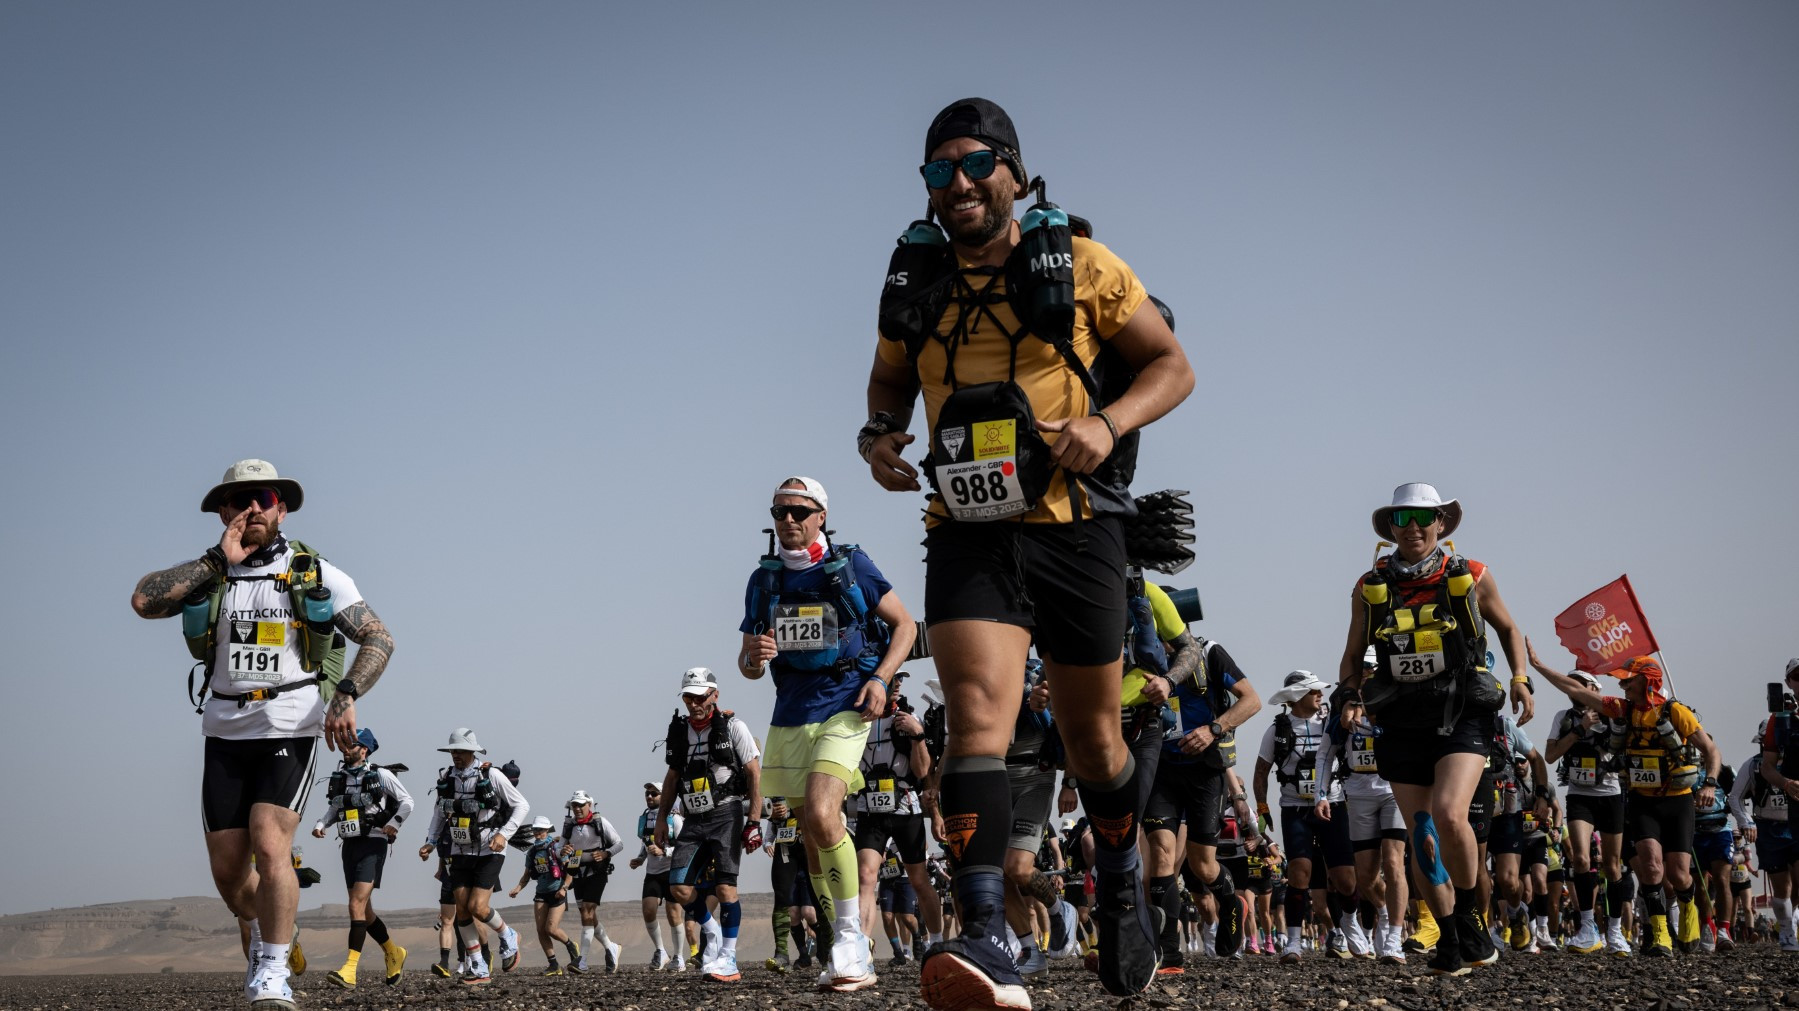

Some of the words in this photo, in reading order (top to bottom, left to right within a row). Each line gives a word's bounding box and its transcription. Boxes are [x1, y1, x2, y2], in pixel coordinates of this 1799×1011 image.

[1030, 252, 1073, 273] MDS
[946, 464, 982, 476] Alexander
[987, 460, 1004, 470] GBR
[950, 470, 1008, 506] 988
[975, 505, 998, 517] MDS
[999, 501, 1025, 514] 2023
[229, 608, 293, 620] ATTACKIN
[778, 622, 821, 642] 1128
[231, 650, 280, 673] 1191
[1399, 658, 1435, 676] 281
[248, 673, 264, 681] MDS
[715, 741, 730, 750] MDS
[1357, 754, 1376, 766] 157
[1575, 771, 1588, 781] 71
[1634, 772, 1656, 783] 240
[1303, 783, 1316, 794] 15
[688, 795, 709, 809] 153
[871, 795, 891, 807] 152
[1771, 797, 1785, 807] 12
[340, 822, 357, 834] 510
[779, 829, 793, 839] 925
[453, 830, 467, 840] 509
[885, 866, 898, 875] 148
